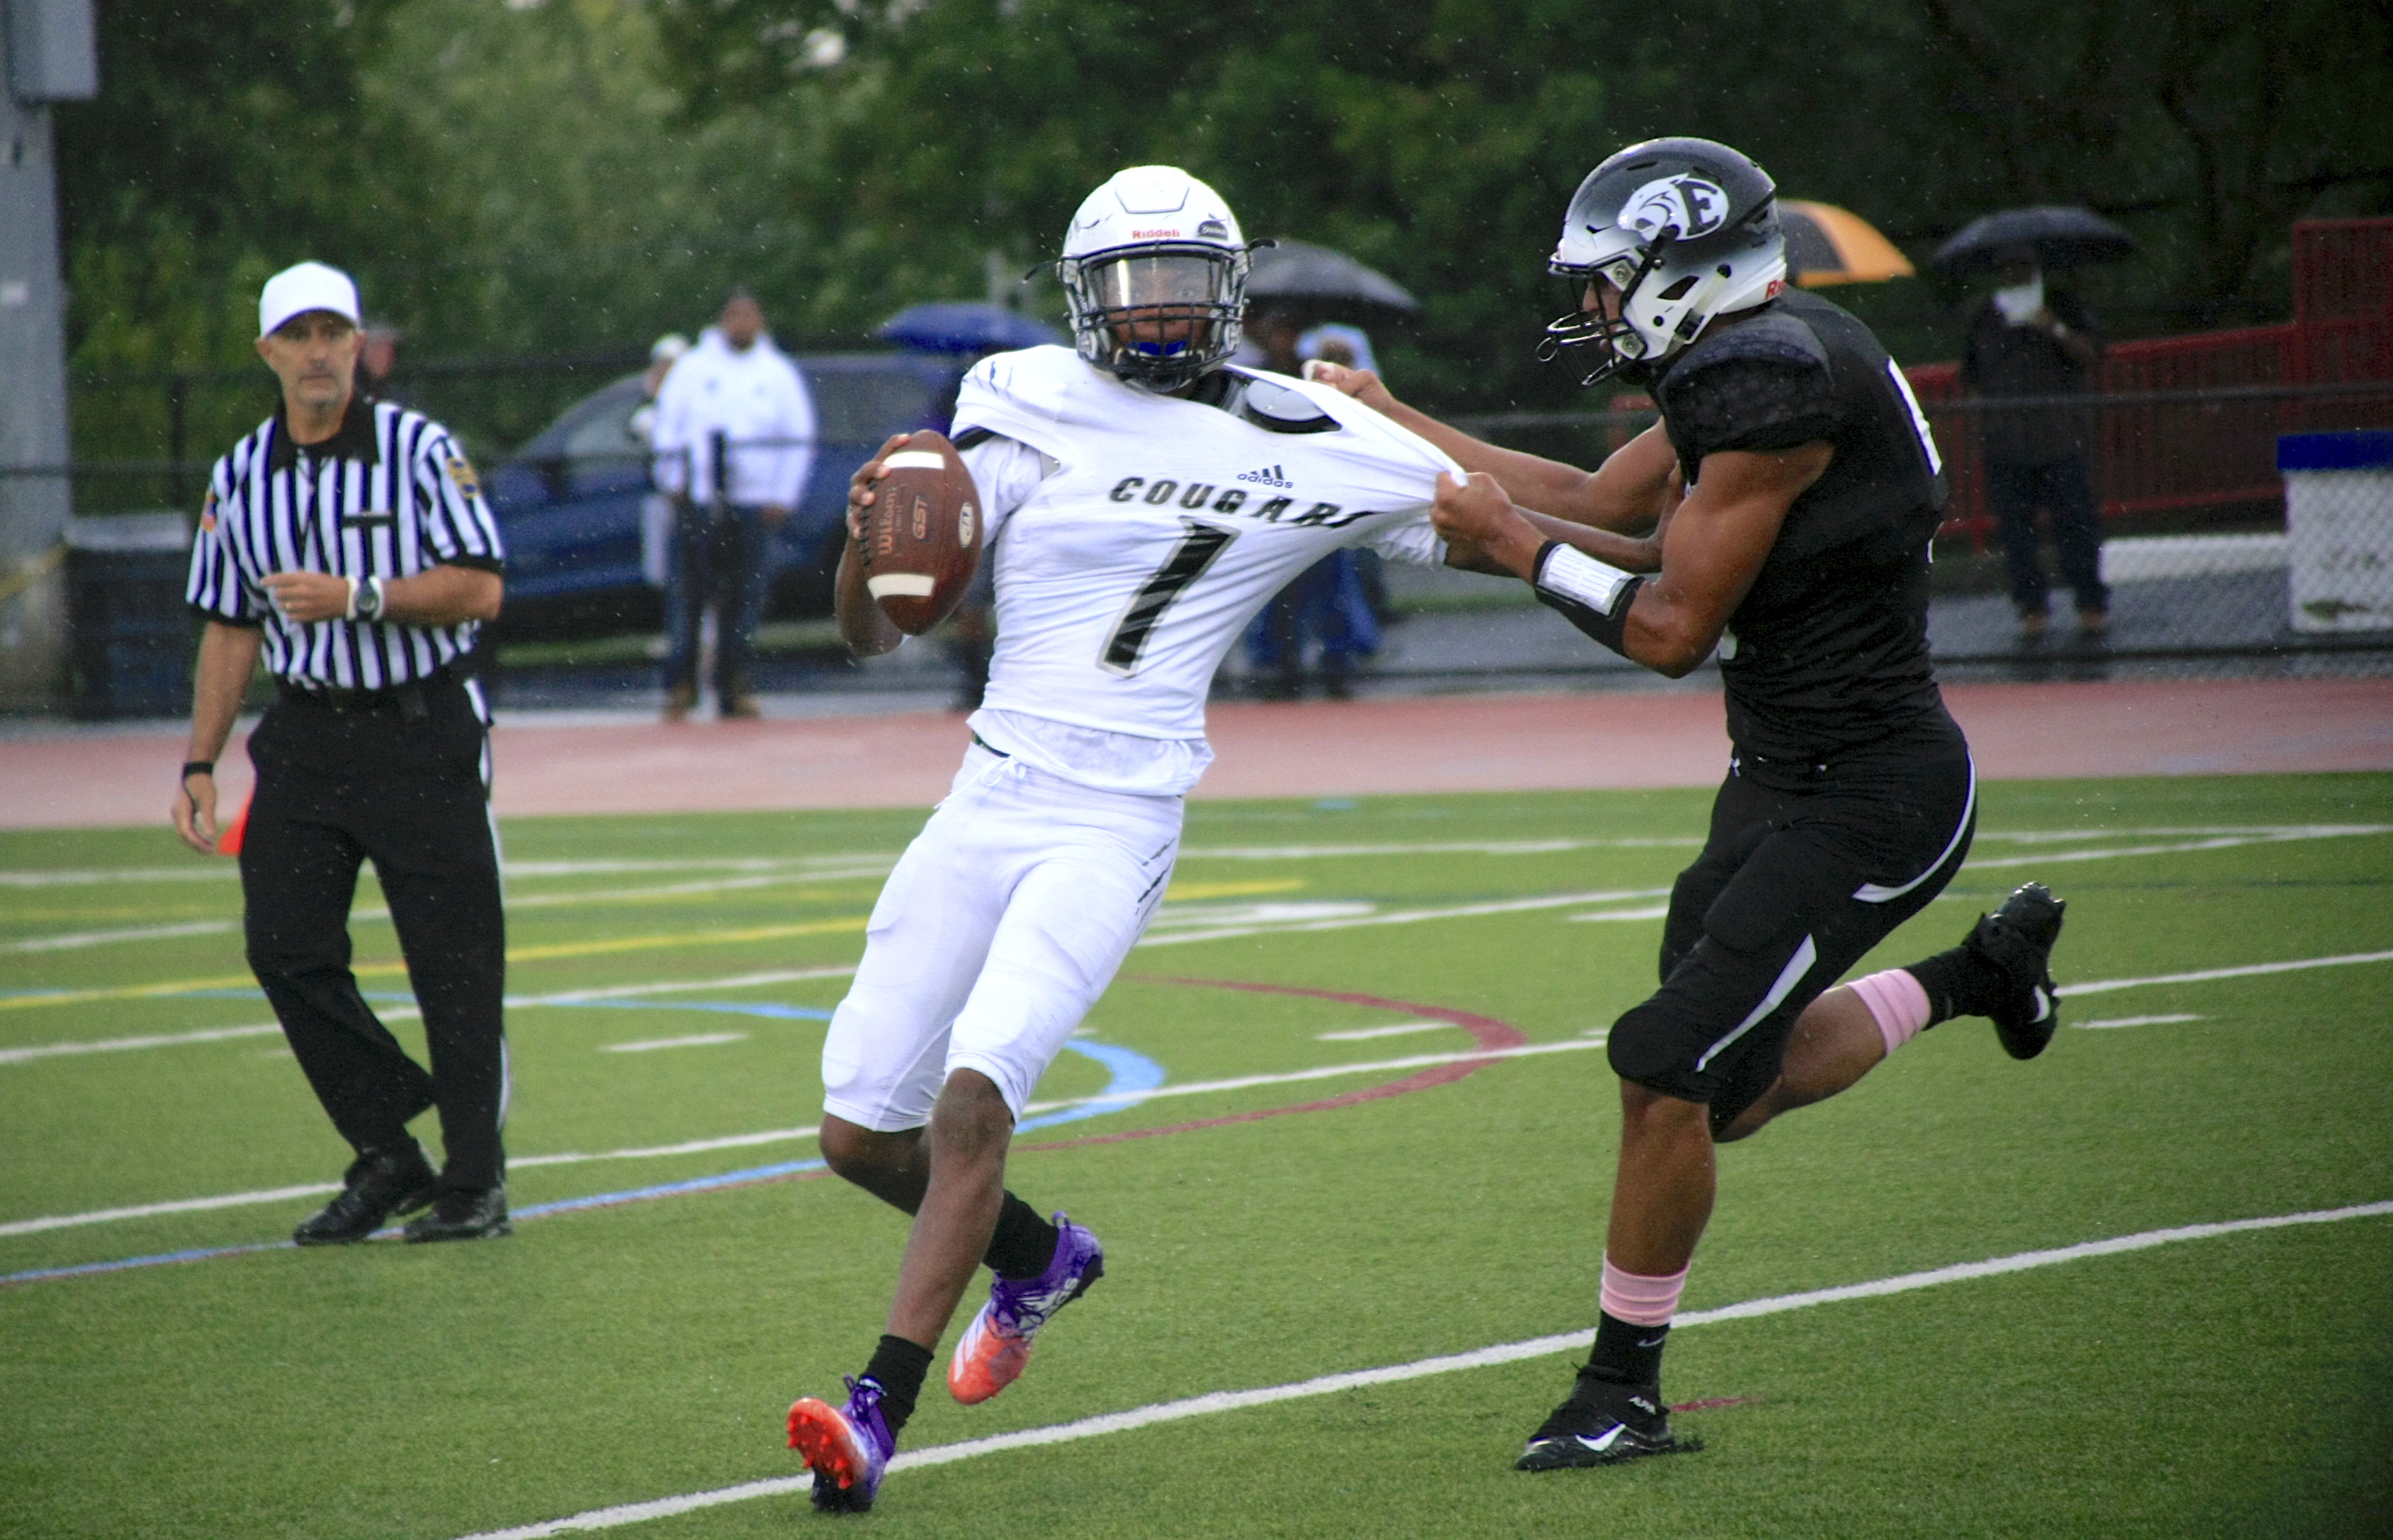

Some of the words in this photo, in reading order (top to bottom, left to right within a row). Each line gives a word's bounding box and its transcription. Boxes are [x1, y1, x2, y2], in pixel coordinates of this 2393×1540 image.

[1676, 180, 1720, 236] E
[1132, 229, 1180, 239] Riddell
[1237, 473, 1293, 490] adidas
[912, 495, 928, 540] GST
